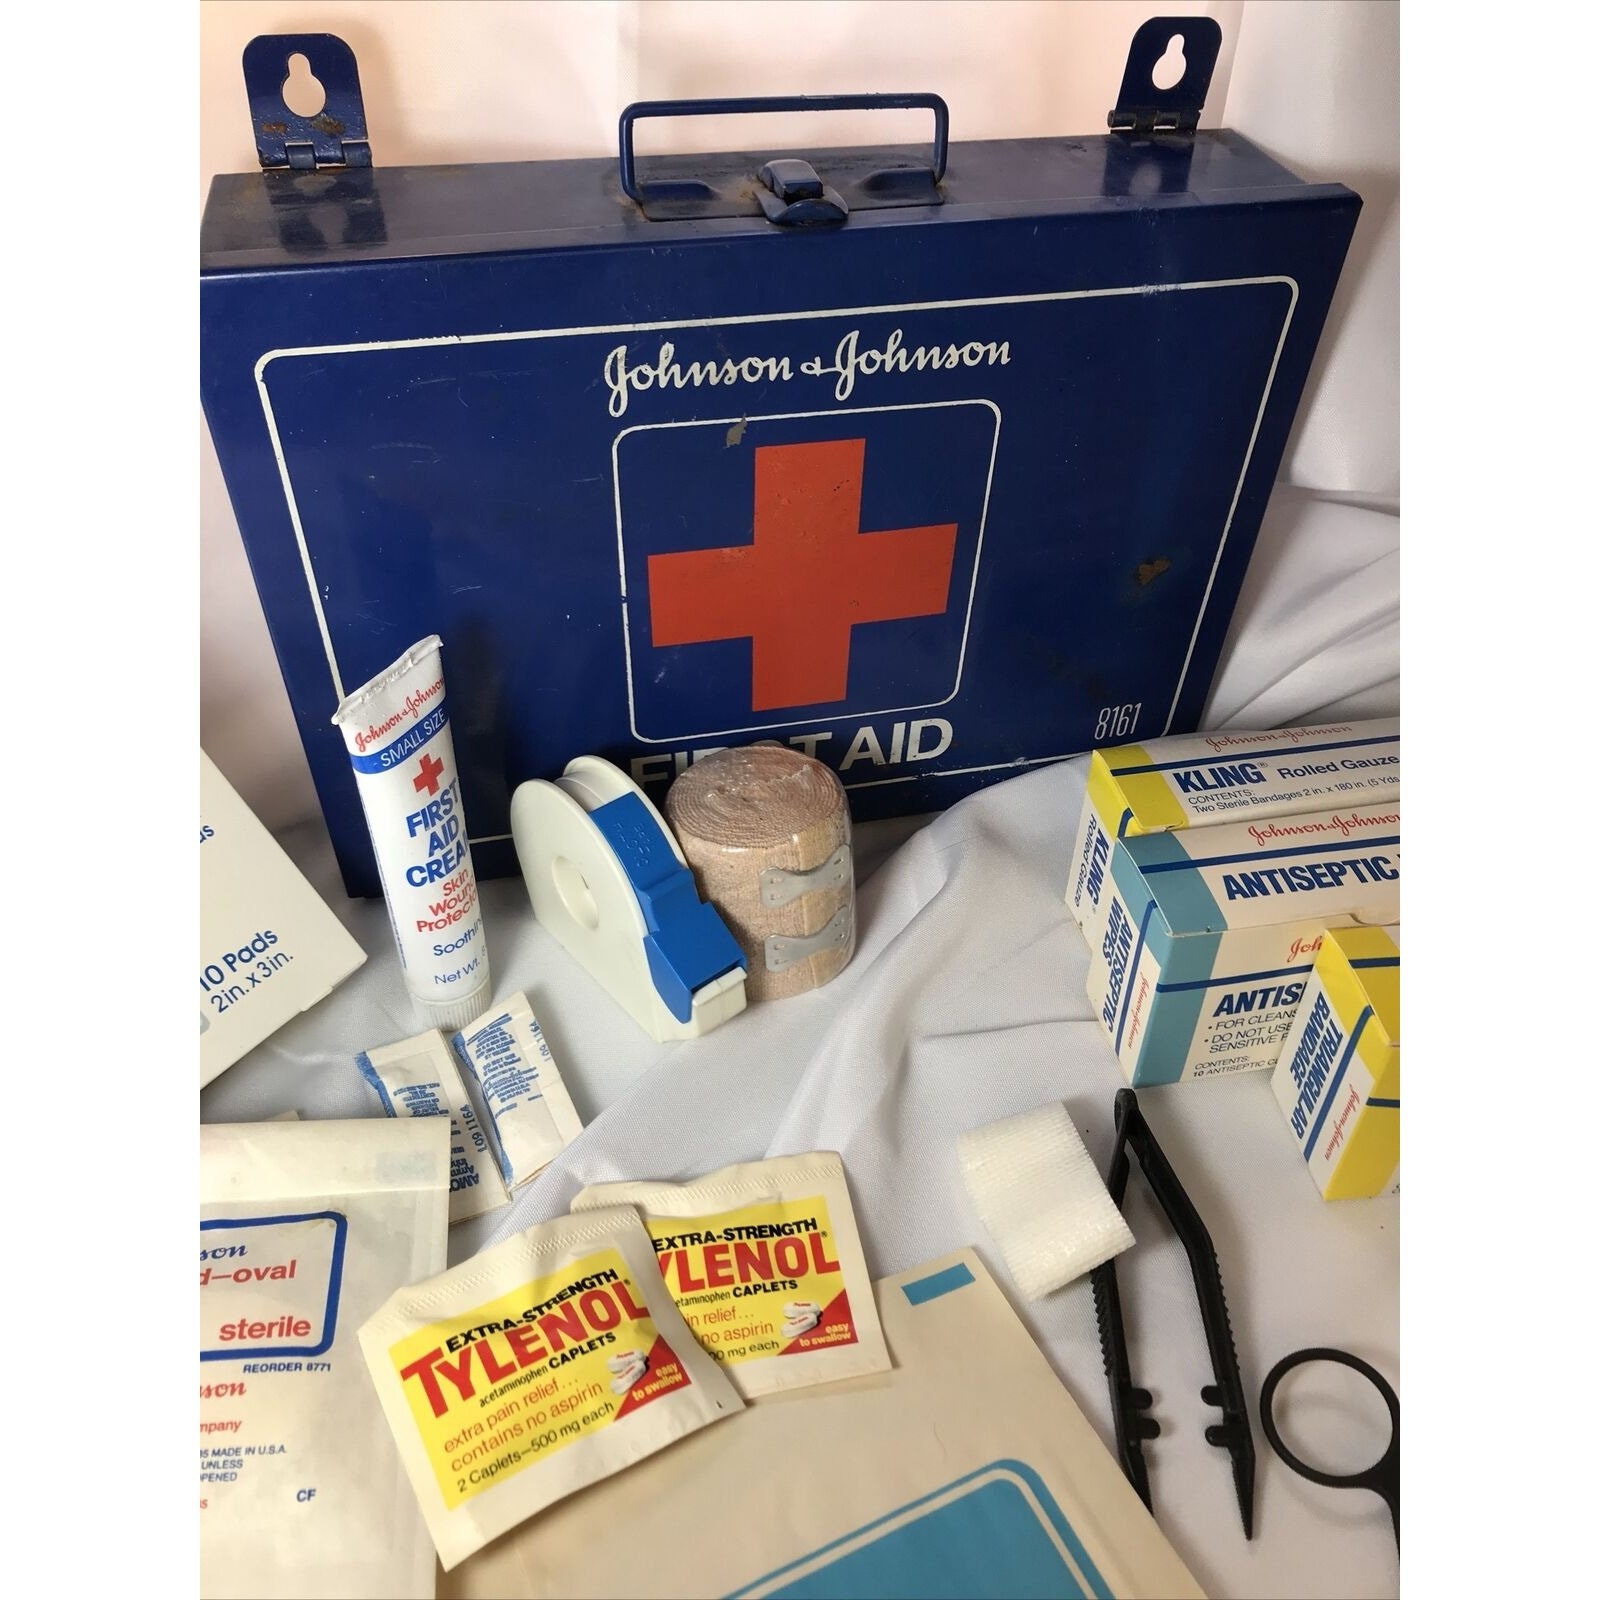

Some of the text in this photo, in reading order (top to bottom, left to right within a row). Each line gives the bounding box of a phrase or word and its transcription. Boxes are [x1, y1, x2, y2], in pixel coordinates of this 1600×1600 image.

[604, 342, 794, 418] Johnson
[835, 328, 1011, 401] Johnson
[354, 713, 402, 753] Johnson
[1094, 702, 1142, 740] 8161
[380, 708, 445, 767] SMALL SIZE
[630, 717, 953, 788] FIT AID
[1205, 733, 1277, 752] Johnson
[1285, 725, 1352, 743] Johnson
[1277, 762, 1339, 780] Rolled
[1341, 755, 1400, 771] Gauze
[406, 778, 459, 837] FIRST
[1188, 788, 1256, 805] CONTENTS:
[1193, 805, 1215, 814] Two
[1216, 798, 1249, 810] Sterile
[1250, 790, 1303, 805] Bandages
[1303, 788, 1311, 796] 2
[1334, 782, 1353, 792] 180
[429, 815, 459, 857] AID
[1248, 822, 1327, 847] Johnson
[406, 830, 469, 887] CREA
[1075, 814, 1097, 907] Rolled Gauze
[1086, 827, 1110, 905] KLING
[443, 869, 468, 896] Skin
[1222, 856, 1400, 901] ANTISEPTIC
[1102, 896, 1123, 967] WIPES
[222, 930, 278, 973] Pads
[434, 970, 461, 985] Net
[1103, 915, 1133, 1033] ANTISEPTIC
[1212, 981, 1307, 1017] ANTIS
[1212, 1032, 1232, 1044] DO
[1235, 1027, 1266, 1040] NOT
[1268, 1021, 1293, 1032] USE
[1215, 1017, 1244, 1031] FOR
[1290, 990, 1331, 1089] BANDAGE
[1209, 1034, 1277, 1054] SENSITIVE
[1206, 1060, 1265, 1076] ANTISEPTIC
[1291, 1019, 1344, 1140] TRIANGULAR
[652, 1218, 818, 1252] EXTRA-STRENGTH
[732, 1279, 798, 1298] CAPLETS
[445, 1268, 619, 1354] EXTRA-STRENGTH
[218, 1316, 311, 1341] sterile
[701, 1331, 720, 1346] no
[723, 1321, 774, 1342] aspirin
[799, 1332, 851, 1347] to swallow
[825, 1323, 849, 1335] easy
[727, 1347, 746, 1357] mg
[749, 1340, 779, 1353] each
[242, 1362, 331, 1374] REORDER 8771
[479, 1332, 617, 1409] acetaminophen CAPLETS
[656, 1363, 678, 1377] easy
[200, 1382, 246, 1398] son
[631, 1390, 645, 1401] to
[644, 1372, 683, 1395] swallow
[444, 1421, 489, 1454] extra
[486, 1400, 520, 1433] pain
[451, 1382, 603, 1473] contains no aspirin
[211, 1447, 241, 1457] MADE
[245, 1446, 256, 1456] IN
[457, 1478, 468, 1493] 2
[560, 1420, 581, 1438] mg
[582, 1402, 615, 1425] each
[201, 1459, 244, 1470] UNLESS
[296, 1489, 317, 1502] CF
